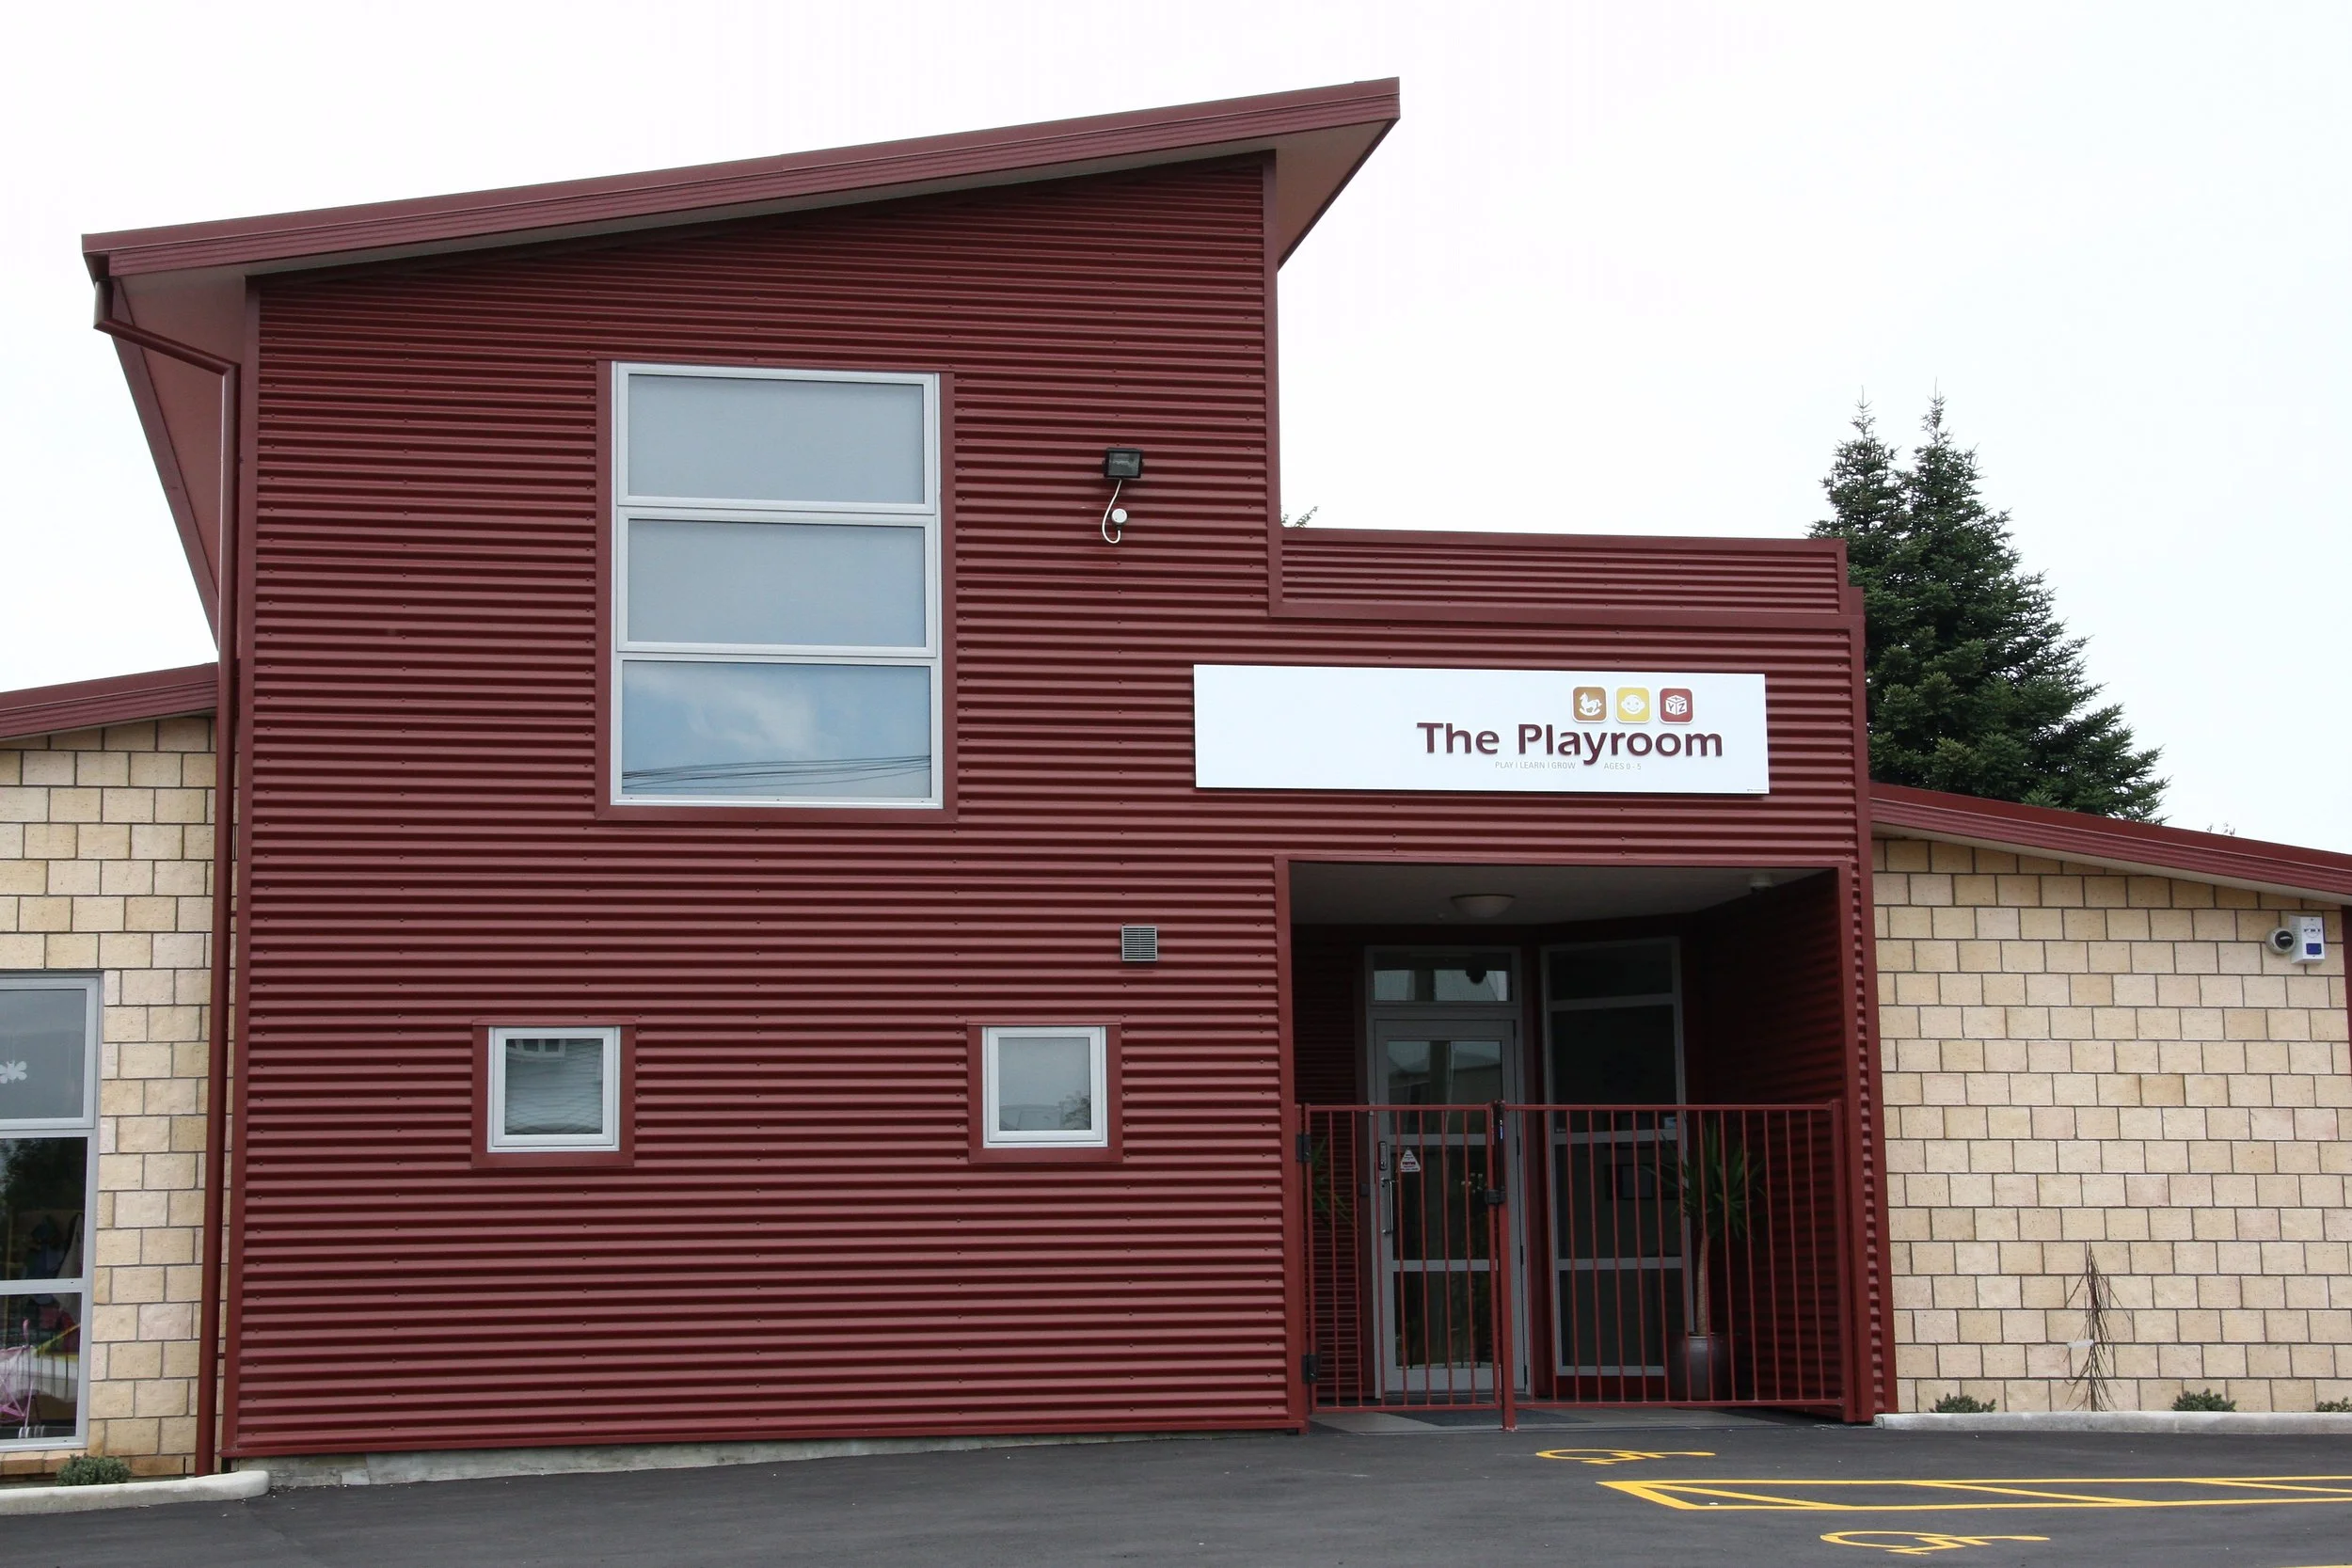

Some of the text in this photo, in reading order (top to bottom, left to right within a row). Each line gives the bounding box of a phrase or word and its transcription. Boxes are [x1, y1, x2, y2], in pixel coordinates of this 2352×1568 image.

[1416, 722, 1723, 765] The Playroom
[1495, 761, 1513, 769] PLAY
